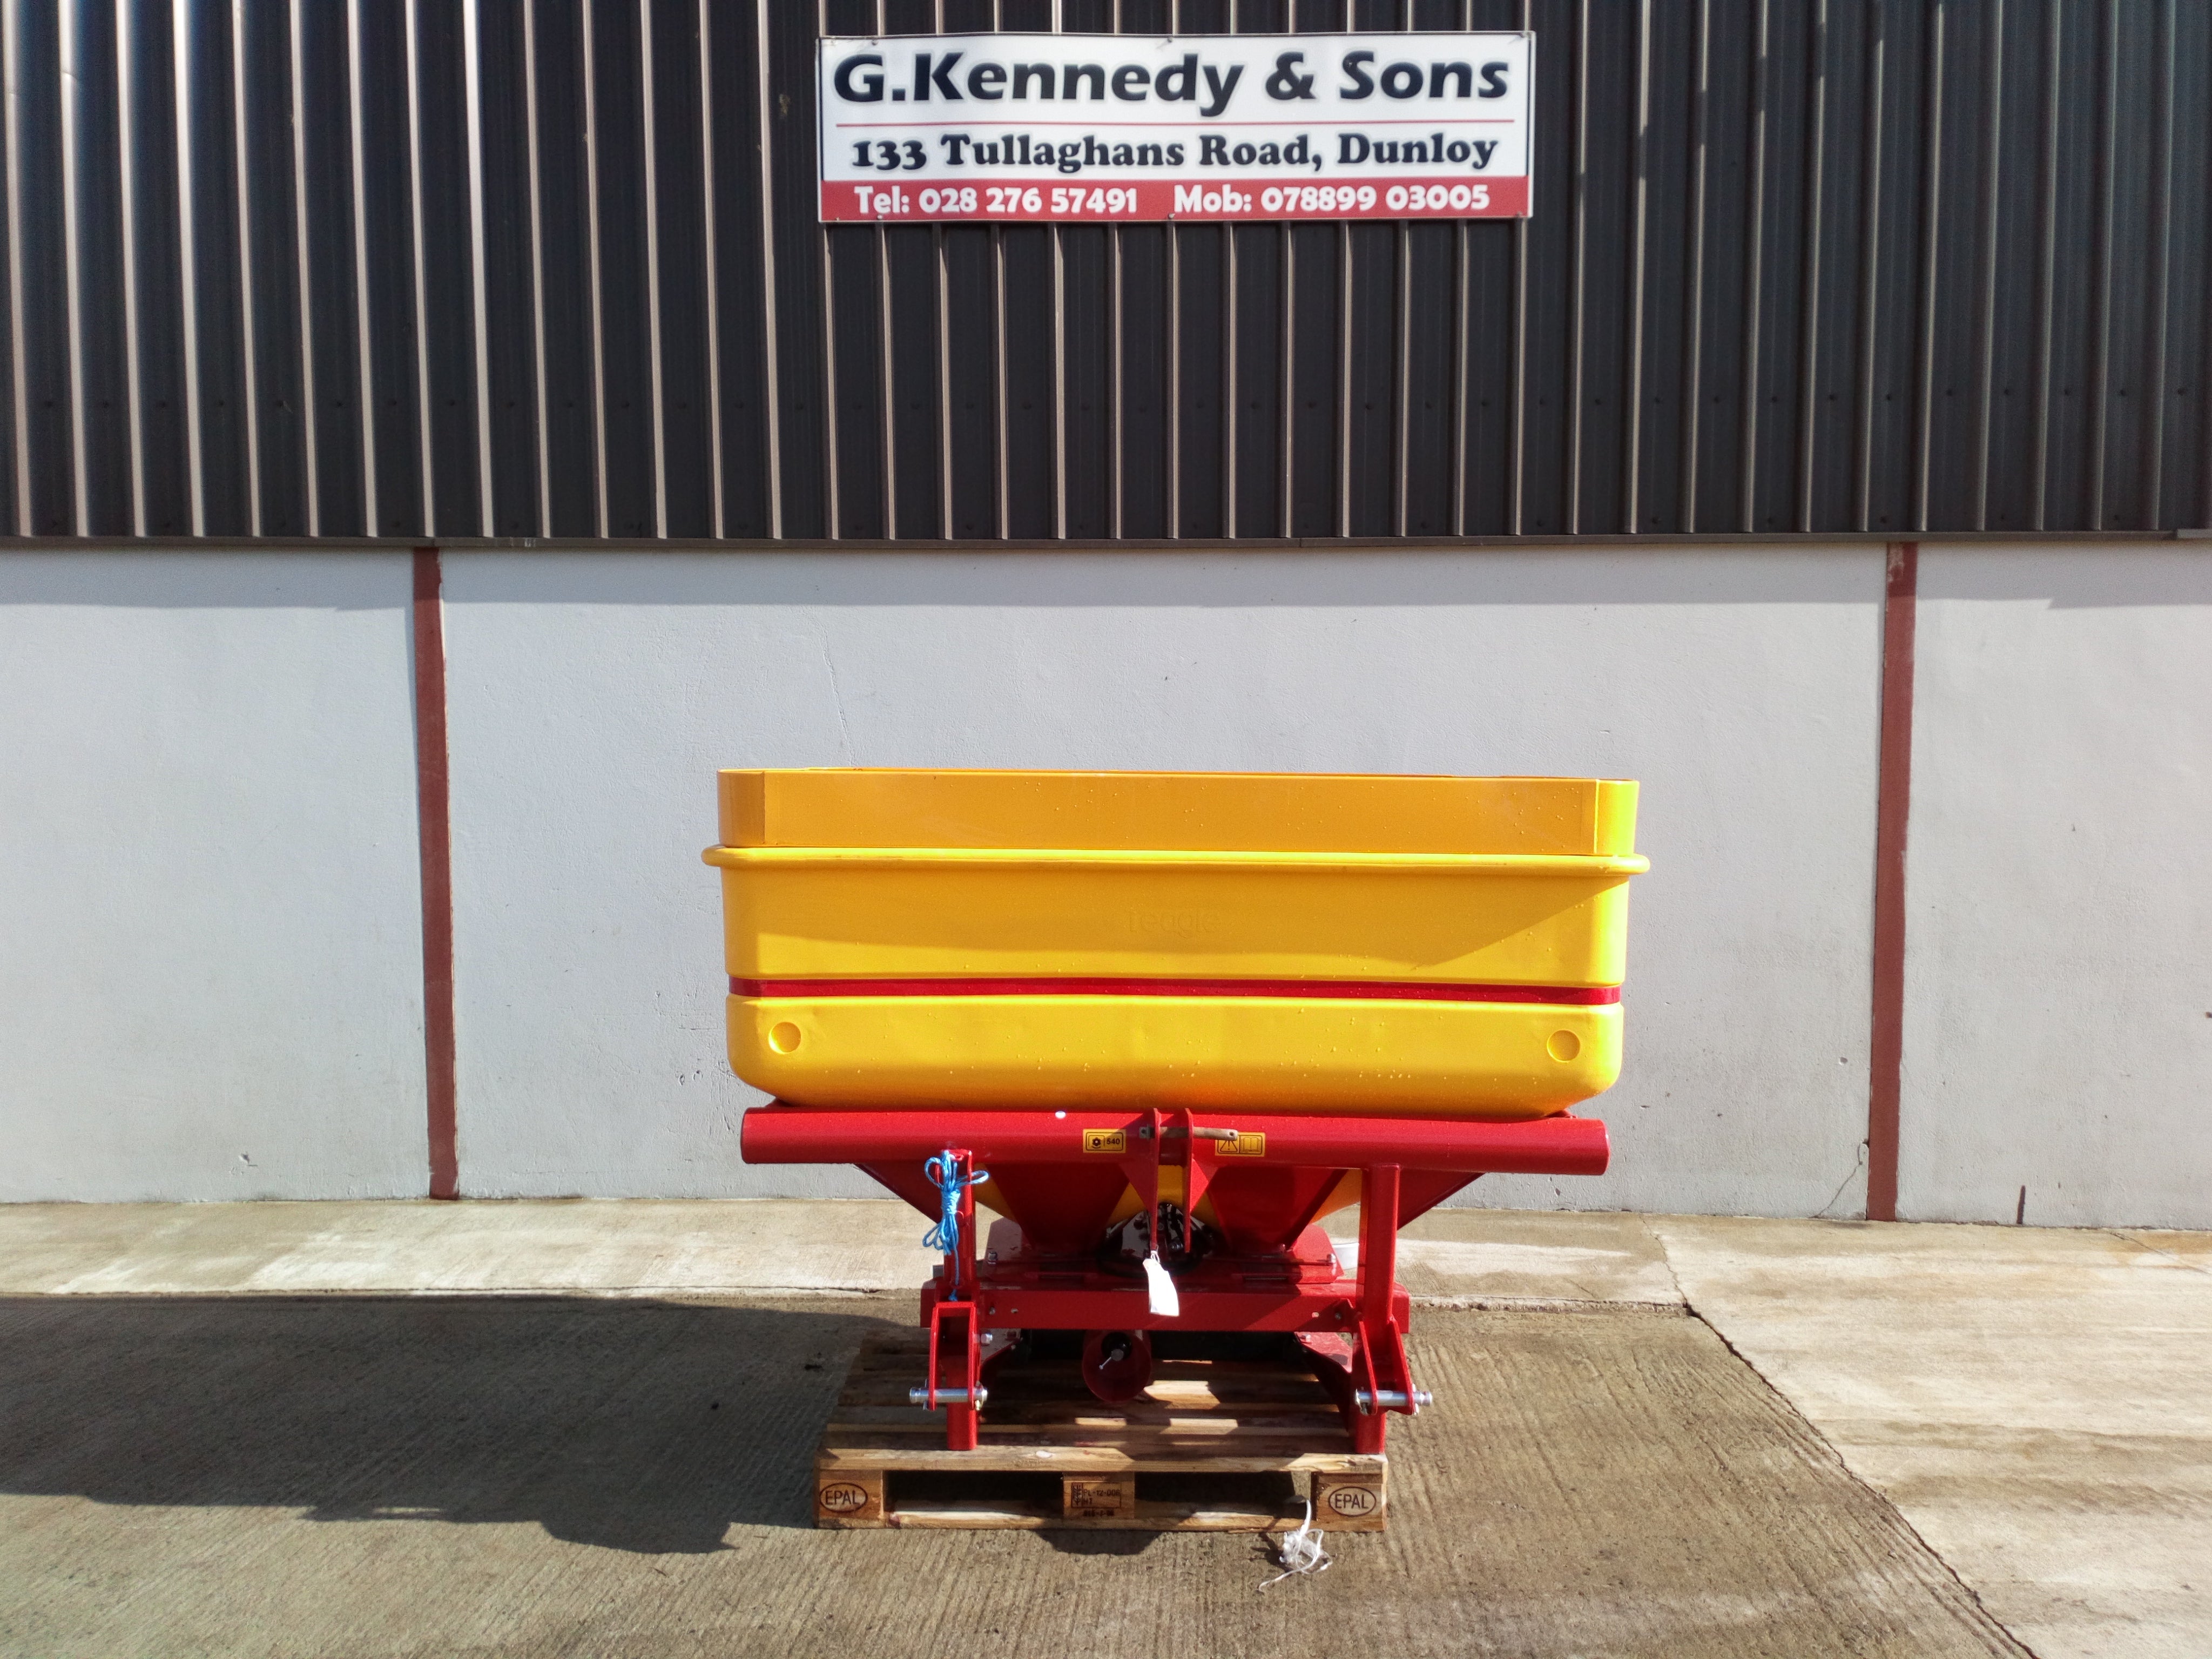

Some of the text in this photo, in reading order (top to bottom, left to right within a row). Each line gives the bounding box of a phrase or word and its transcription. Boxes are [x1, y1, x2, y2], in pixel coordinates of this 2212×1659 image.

[1265, 51, 1316, 100] &
[1340, 50, 1508, 100] Sons
[852, 133, 1498, 173] 133 Tullaghans Road, Dunloy
[854, 184, 1490, 214] Tel: 028 276 57491 Mob: 078899 03005
[825, 1489, 861, 1505] EPAL
[1334, 1493, 1369, 1509] EPAL
